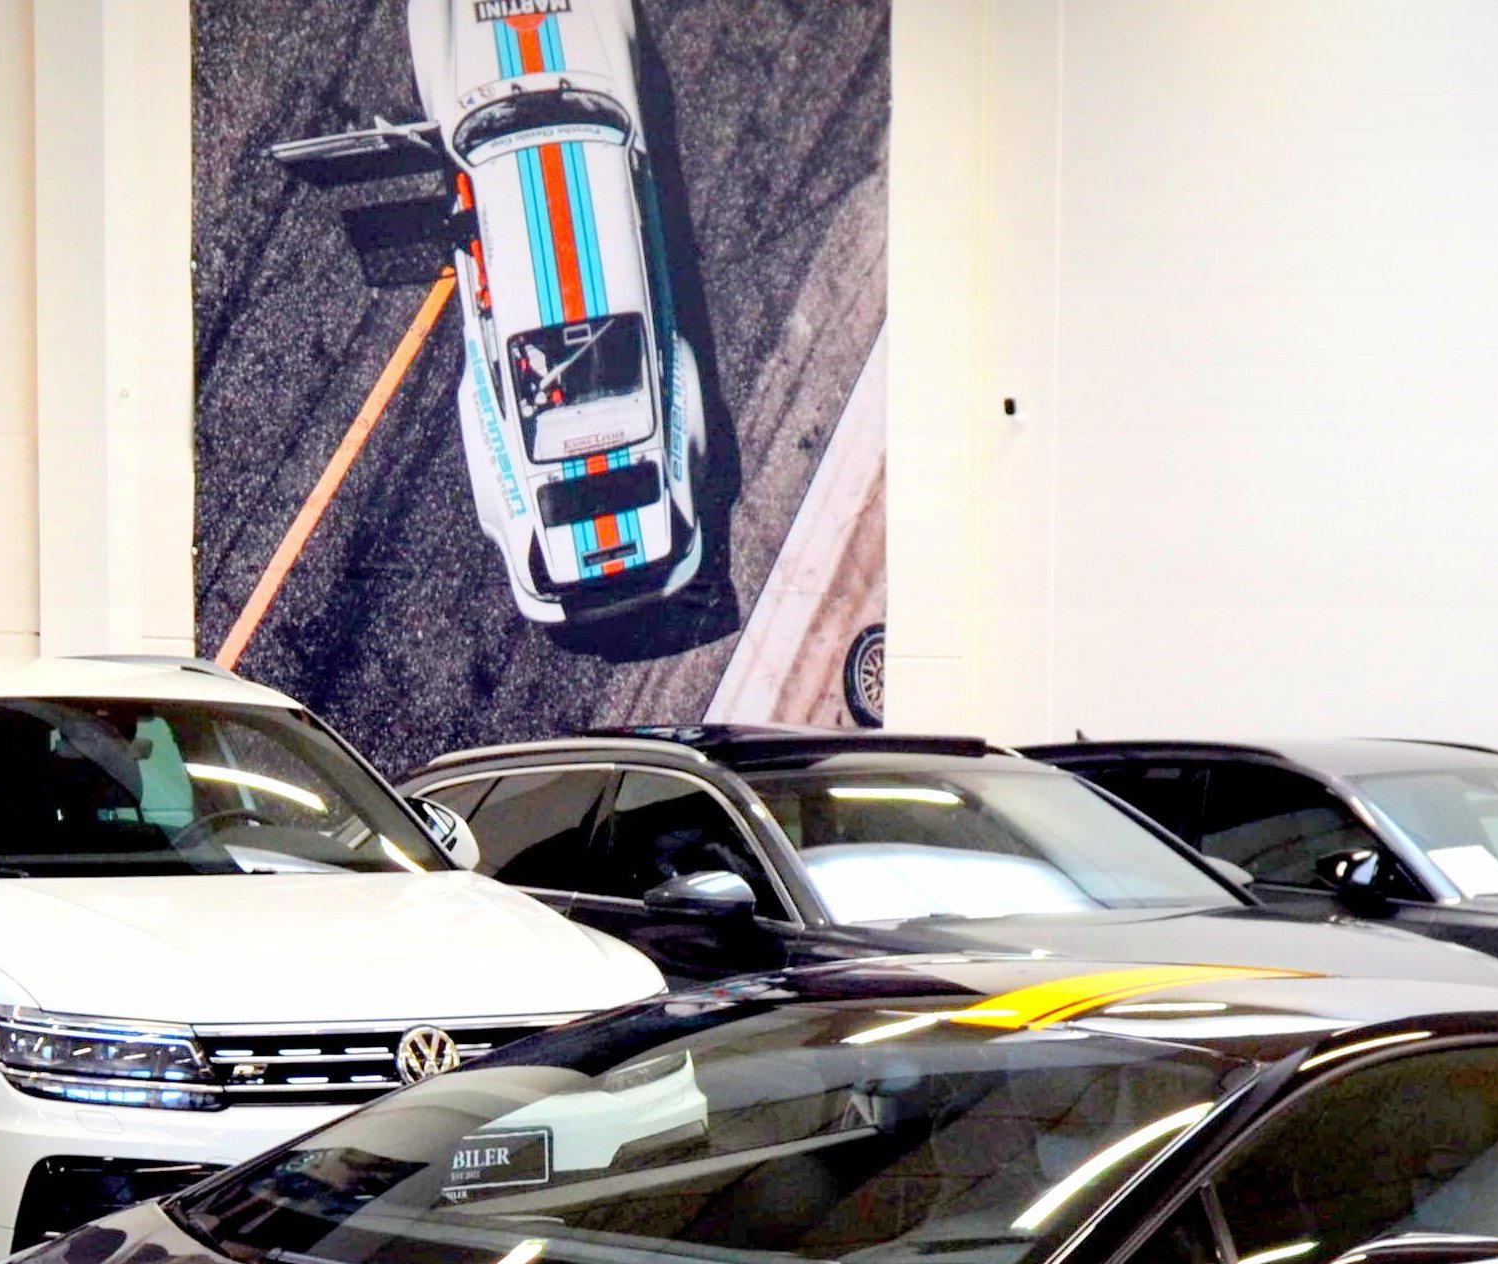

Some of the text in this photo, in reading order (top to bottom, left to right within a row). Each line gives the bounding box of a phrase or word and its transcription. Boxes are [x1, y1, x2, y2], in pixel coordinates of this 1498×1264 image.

[478, 0, 567, 20] MARTINI
[469, 339, 527, 516] eisenmann
[452, 1147, 510, 1169] BILER
